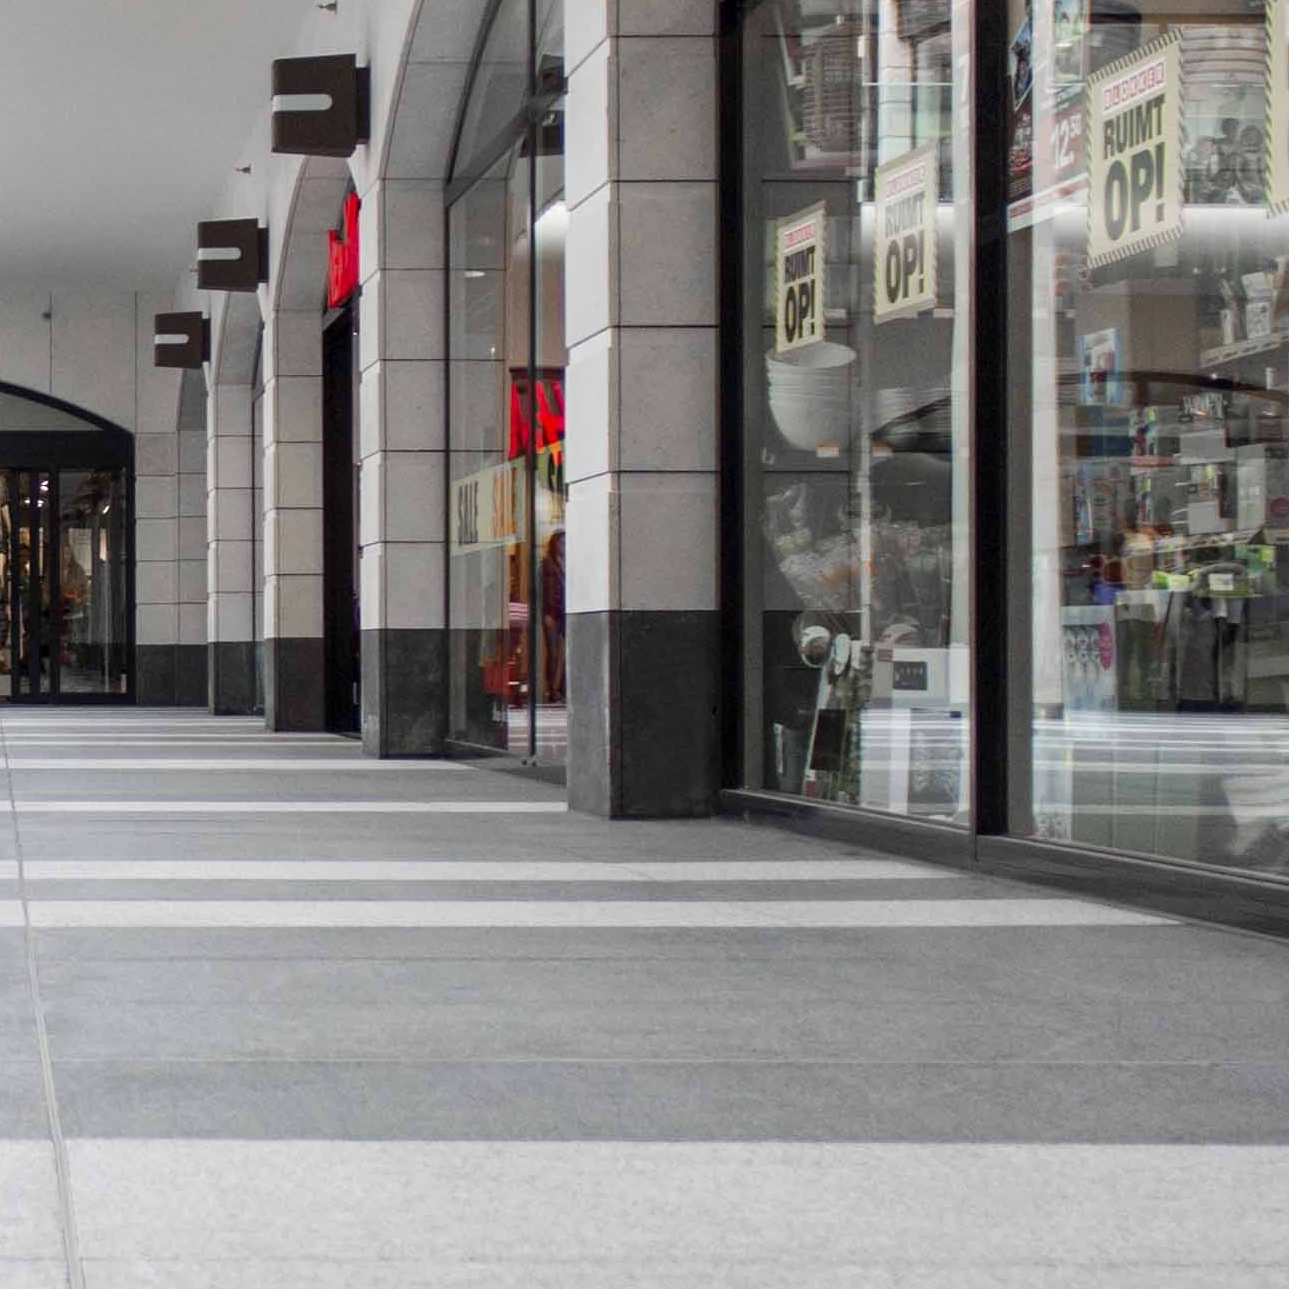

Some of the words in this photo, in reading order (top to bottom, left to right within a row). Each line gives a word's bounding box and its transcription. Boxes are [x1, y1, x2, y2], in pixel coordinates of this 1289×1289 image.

[1103, 93, 1165, 160] RUIMT
[1104, 141, 1166, 242] OP!
[886, 230, 924, 304] OP!
[785, 278, 816, 343] OP!
